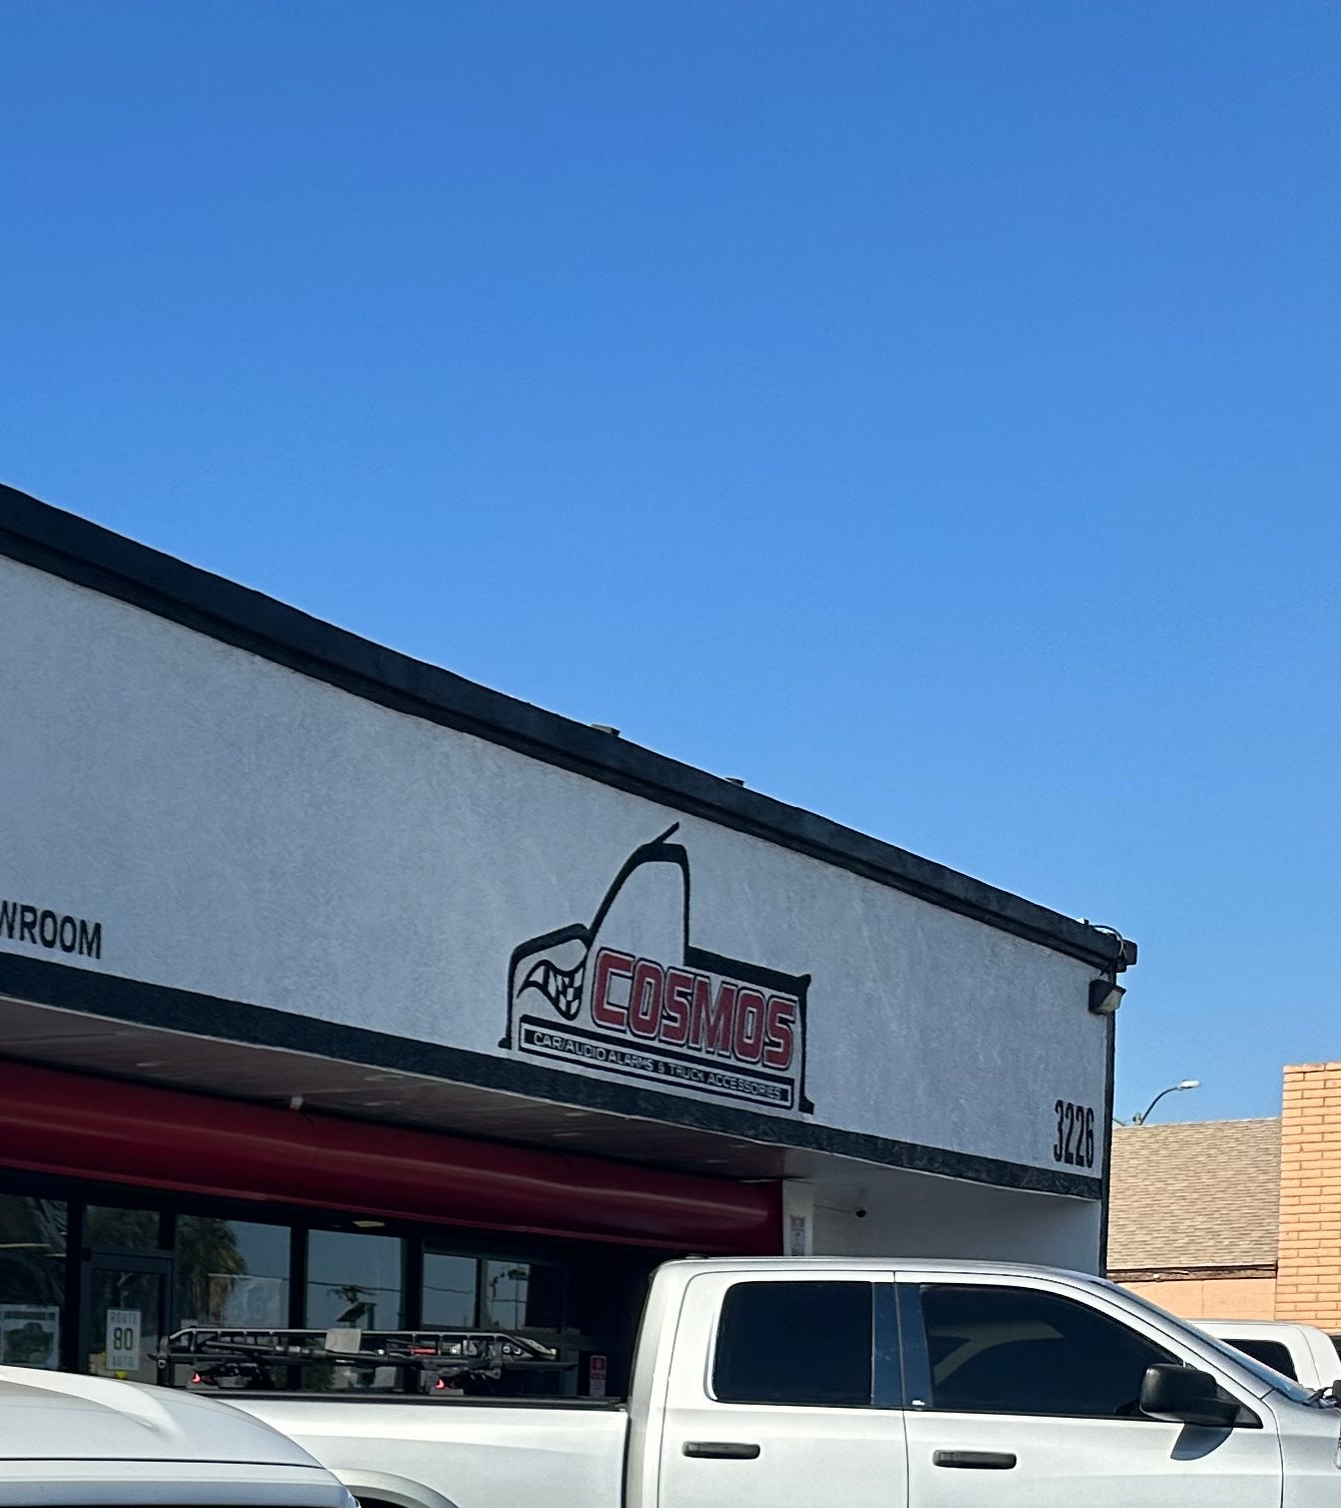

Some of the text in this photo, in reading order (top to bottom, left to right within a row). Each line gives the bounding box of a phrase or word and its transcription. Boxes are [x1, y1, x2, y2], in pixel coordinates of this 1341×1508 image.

[591, 946, 797, 1070] COSMOS
[608, 1052, 655, 1072] ALARMS
[668, 1063, 705, 1083] TRUCK
[706, 1072, 783, 1100] ACCESSORIES
[1053, 1099, 1095, 1168] 3226
[113, 1327, 134, 1350] 80
